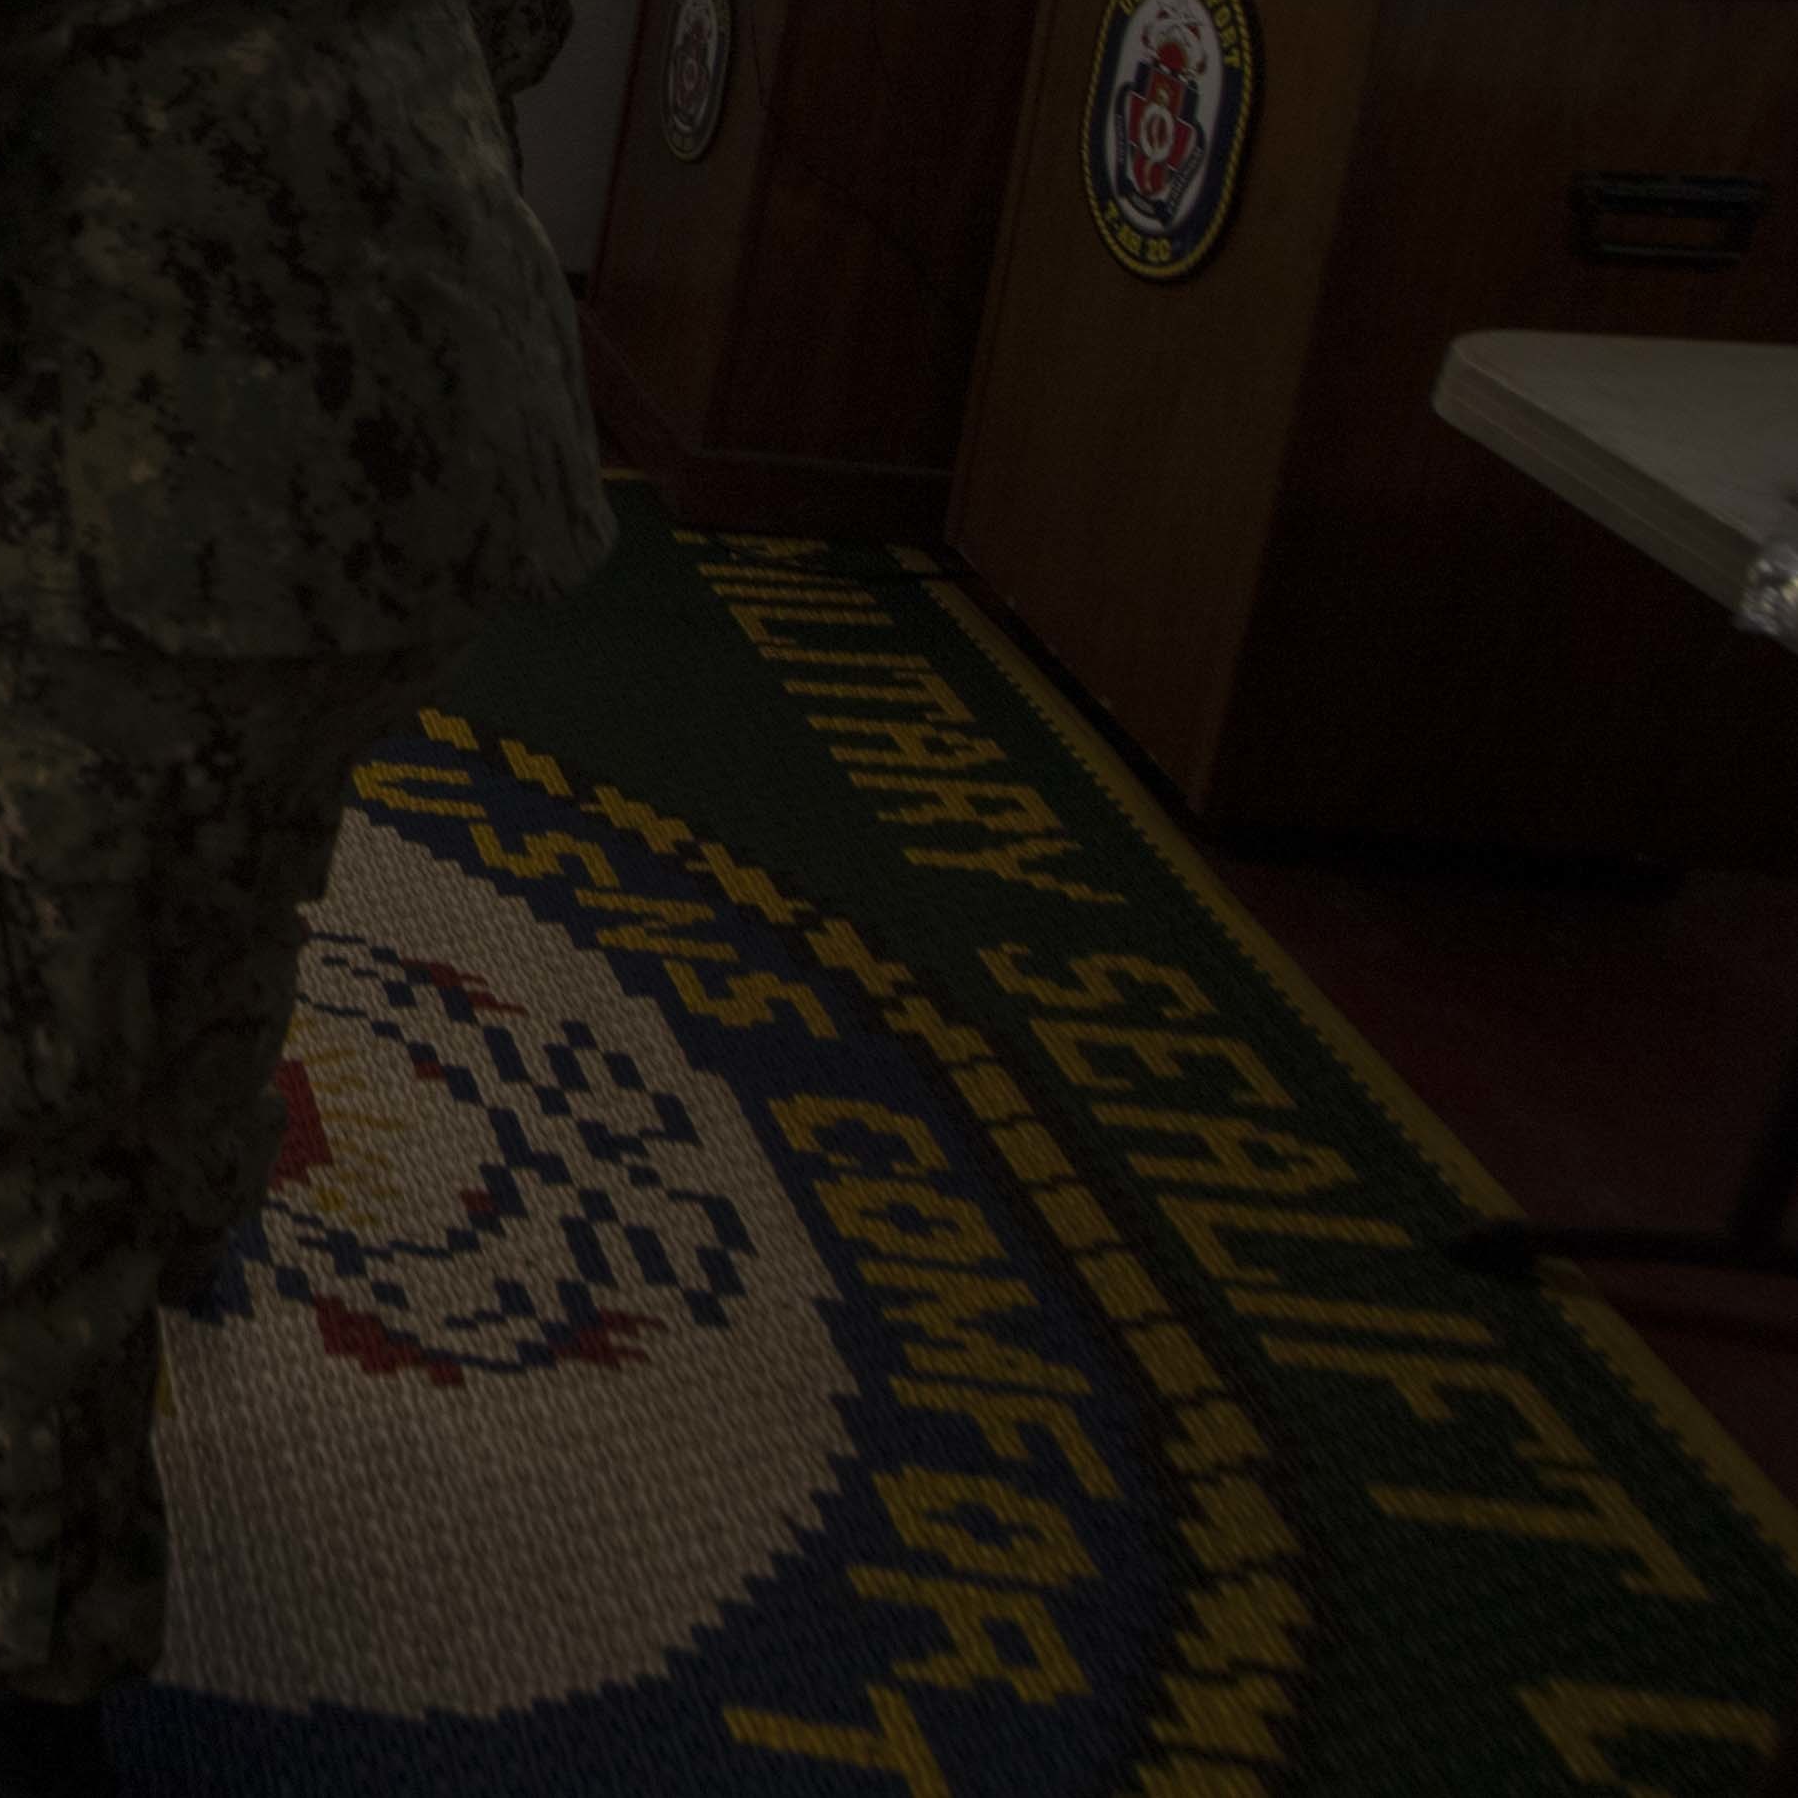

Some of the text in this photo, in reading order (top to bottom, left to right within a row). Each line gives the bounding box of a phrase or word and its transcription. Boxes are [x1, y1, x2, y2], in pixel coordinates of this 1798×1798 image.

[352, 758, 1124, 1798] USNS COMFORT
[670, 528, 1128, 906] MILITARY
[975, 938, 1718, 1605] SEALIFT
